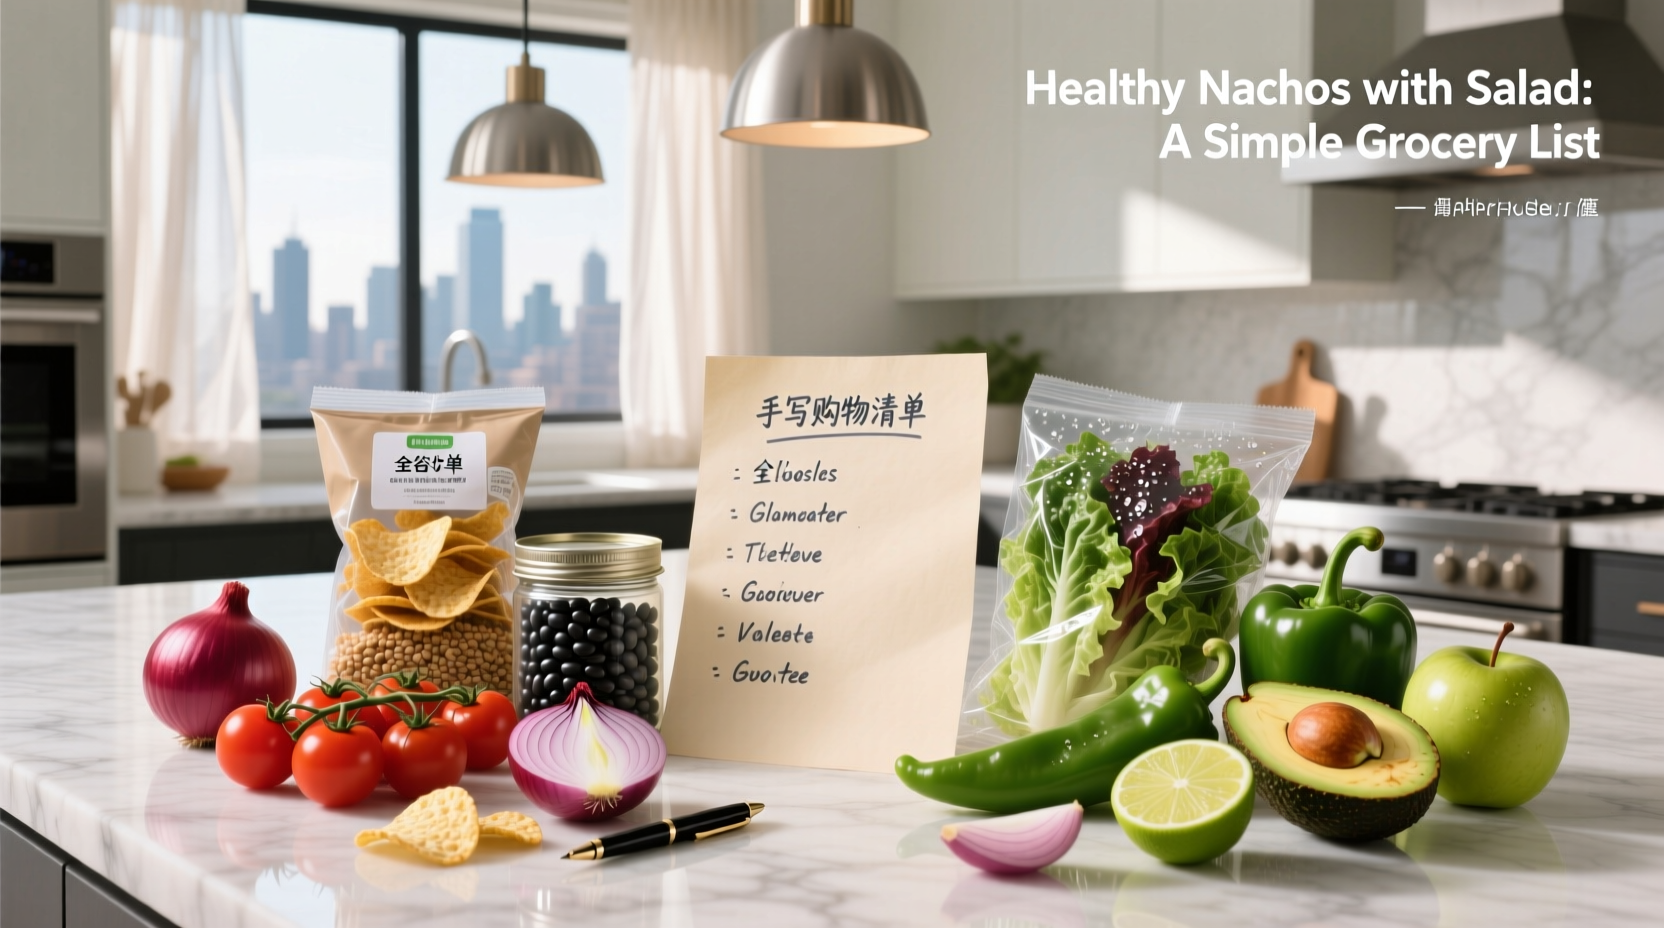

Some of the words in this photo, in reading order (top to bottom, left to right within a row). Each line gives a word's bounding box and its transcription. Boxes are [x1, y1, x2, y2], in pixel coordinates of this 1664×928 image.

[755, 391, 927, 429] 手写购物清单
